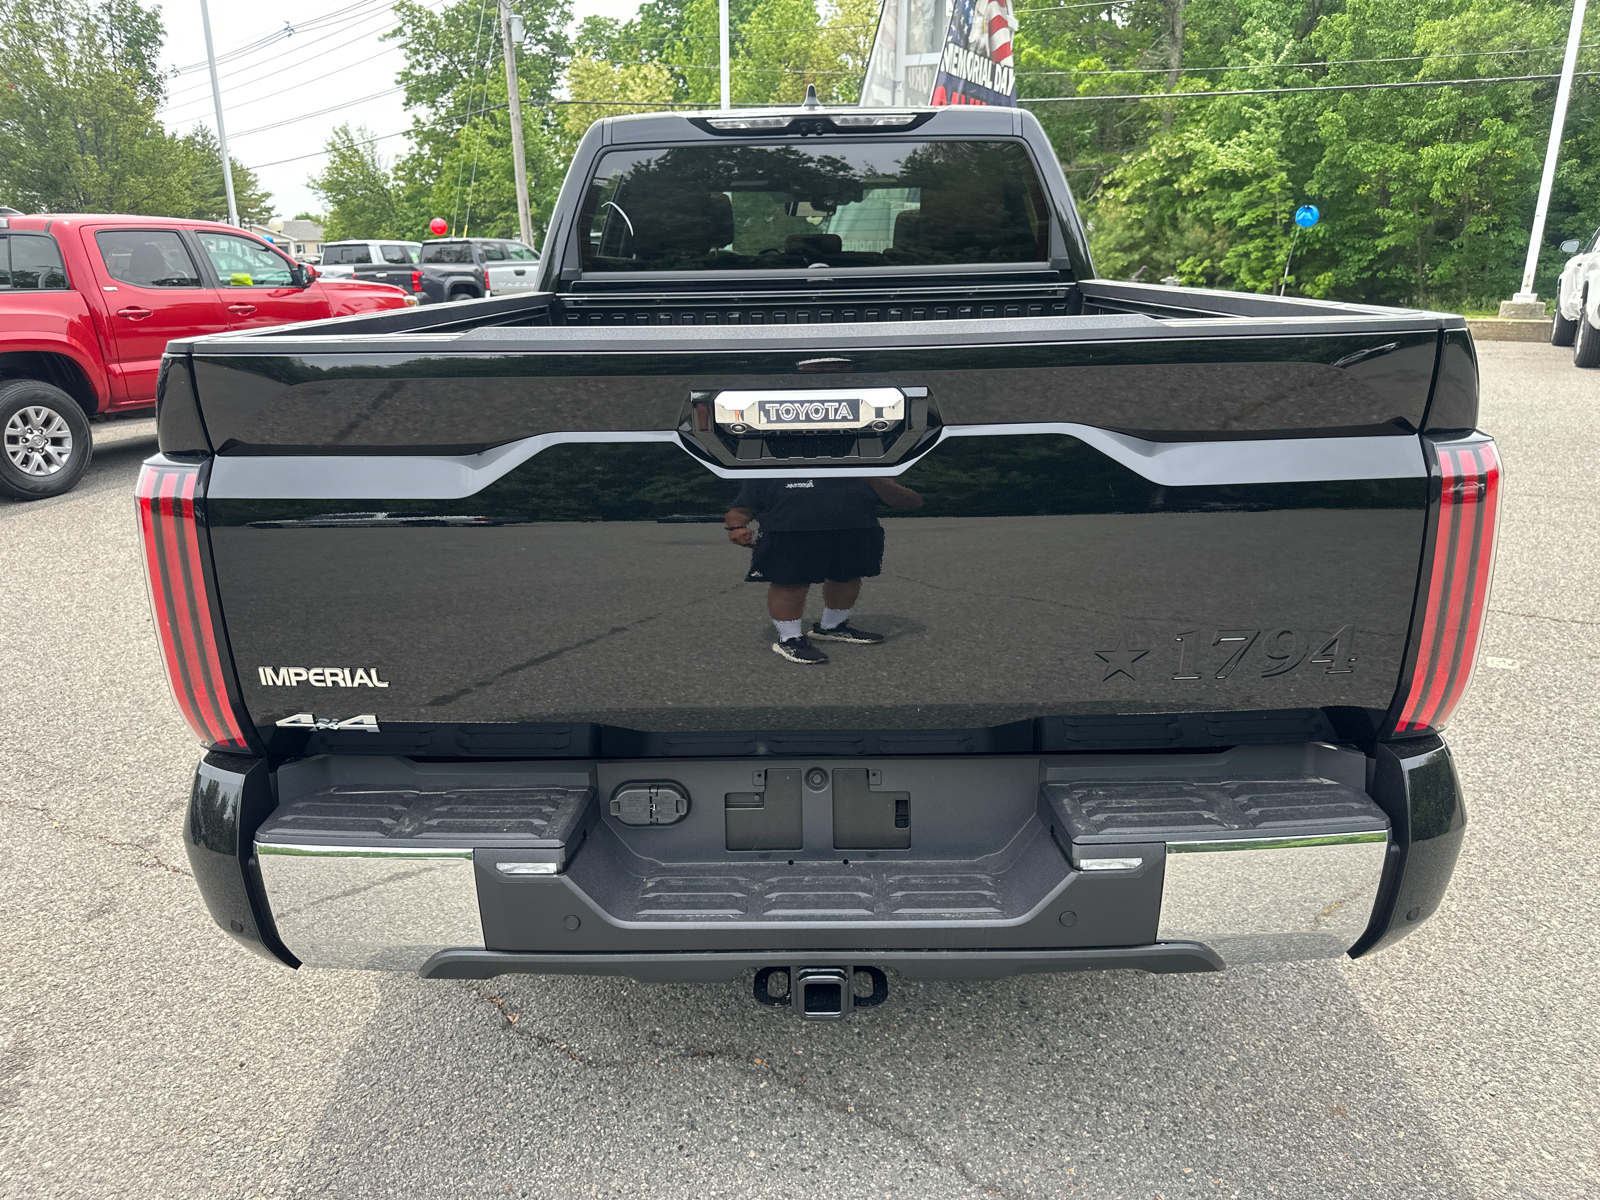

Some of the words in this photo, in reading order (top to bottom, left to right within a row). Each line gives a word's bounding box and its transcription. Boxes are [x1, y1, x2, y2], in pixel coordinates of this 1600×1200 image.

[941, 42, 992, 90] MEMORIAL
[994, 62, 1015, 96] DAY
[765, 402, 853, 421] TOYOTA
[1171, 624, 1357, 681] 1794
[258, 666, 390, 688] IMPERIAL
